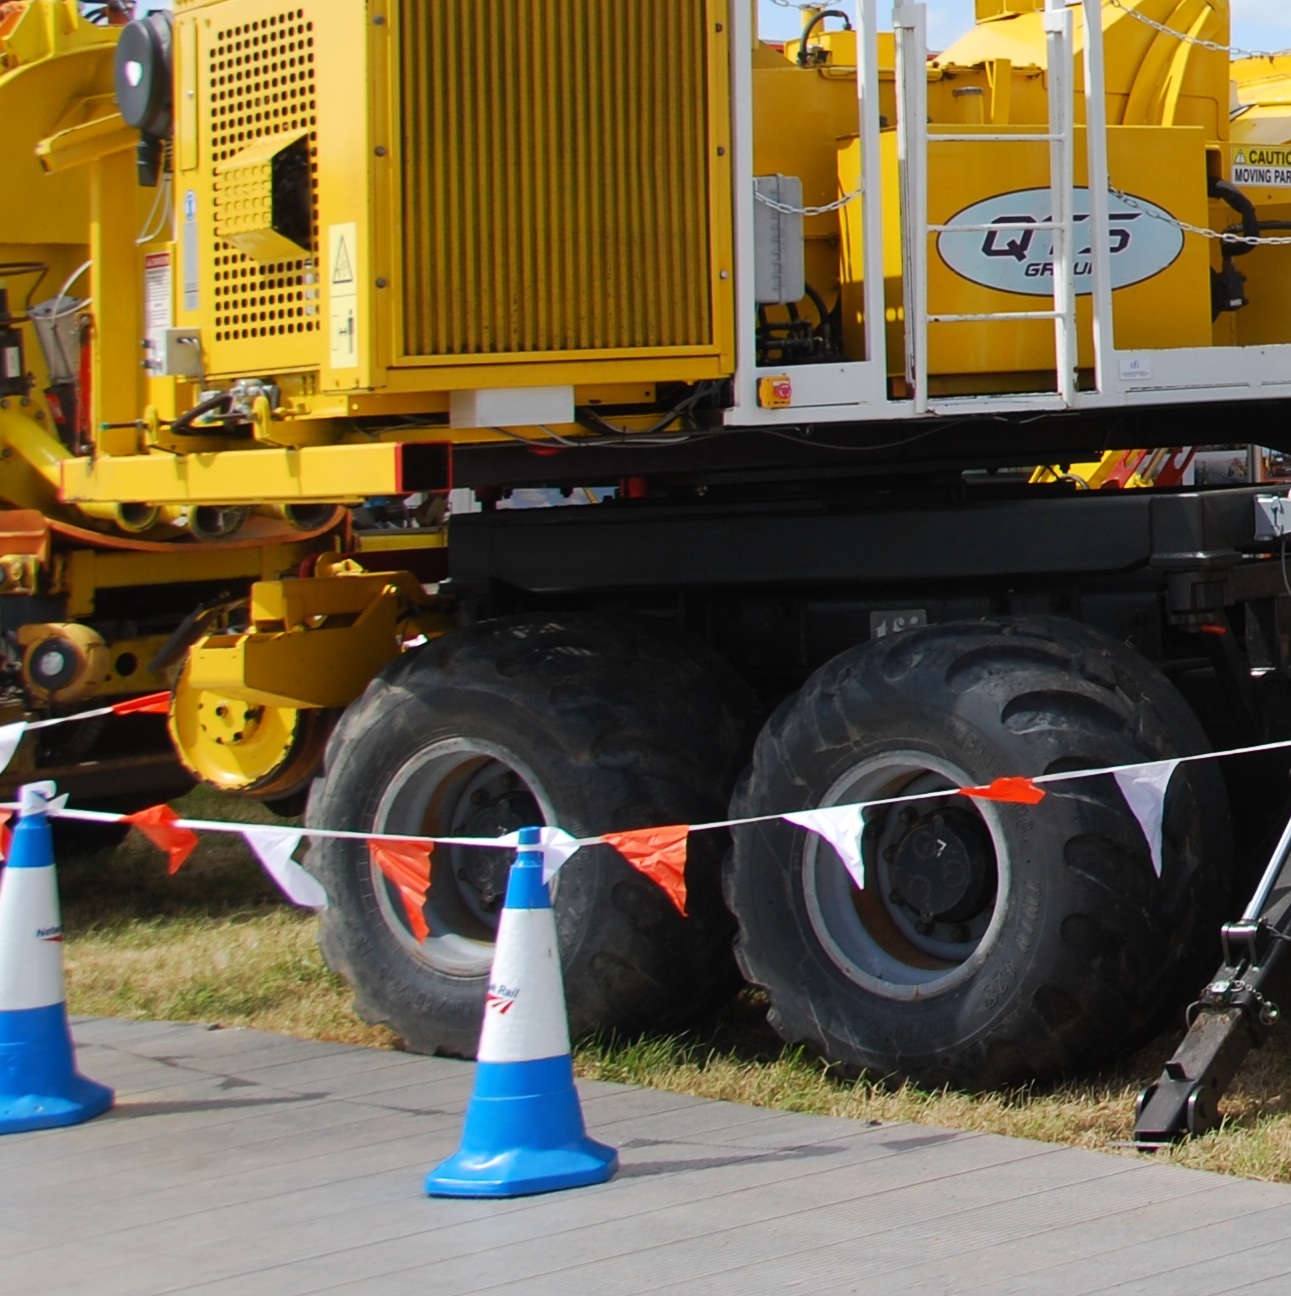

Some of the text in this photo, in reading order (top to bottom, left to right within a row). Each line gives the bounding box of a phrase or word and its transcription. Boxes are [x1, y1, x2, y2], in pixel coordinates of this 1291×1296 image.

[1235, 168, 1271, 183] MOVING
[1024, 262, 1093, 277] GRU
[498, 985, 520, 999] Rail
